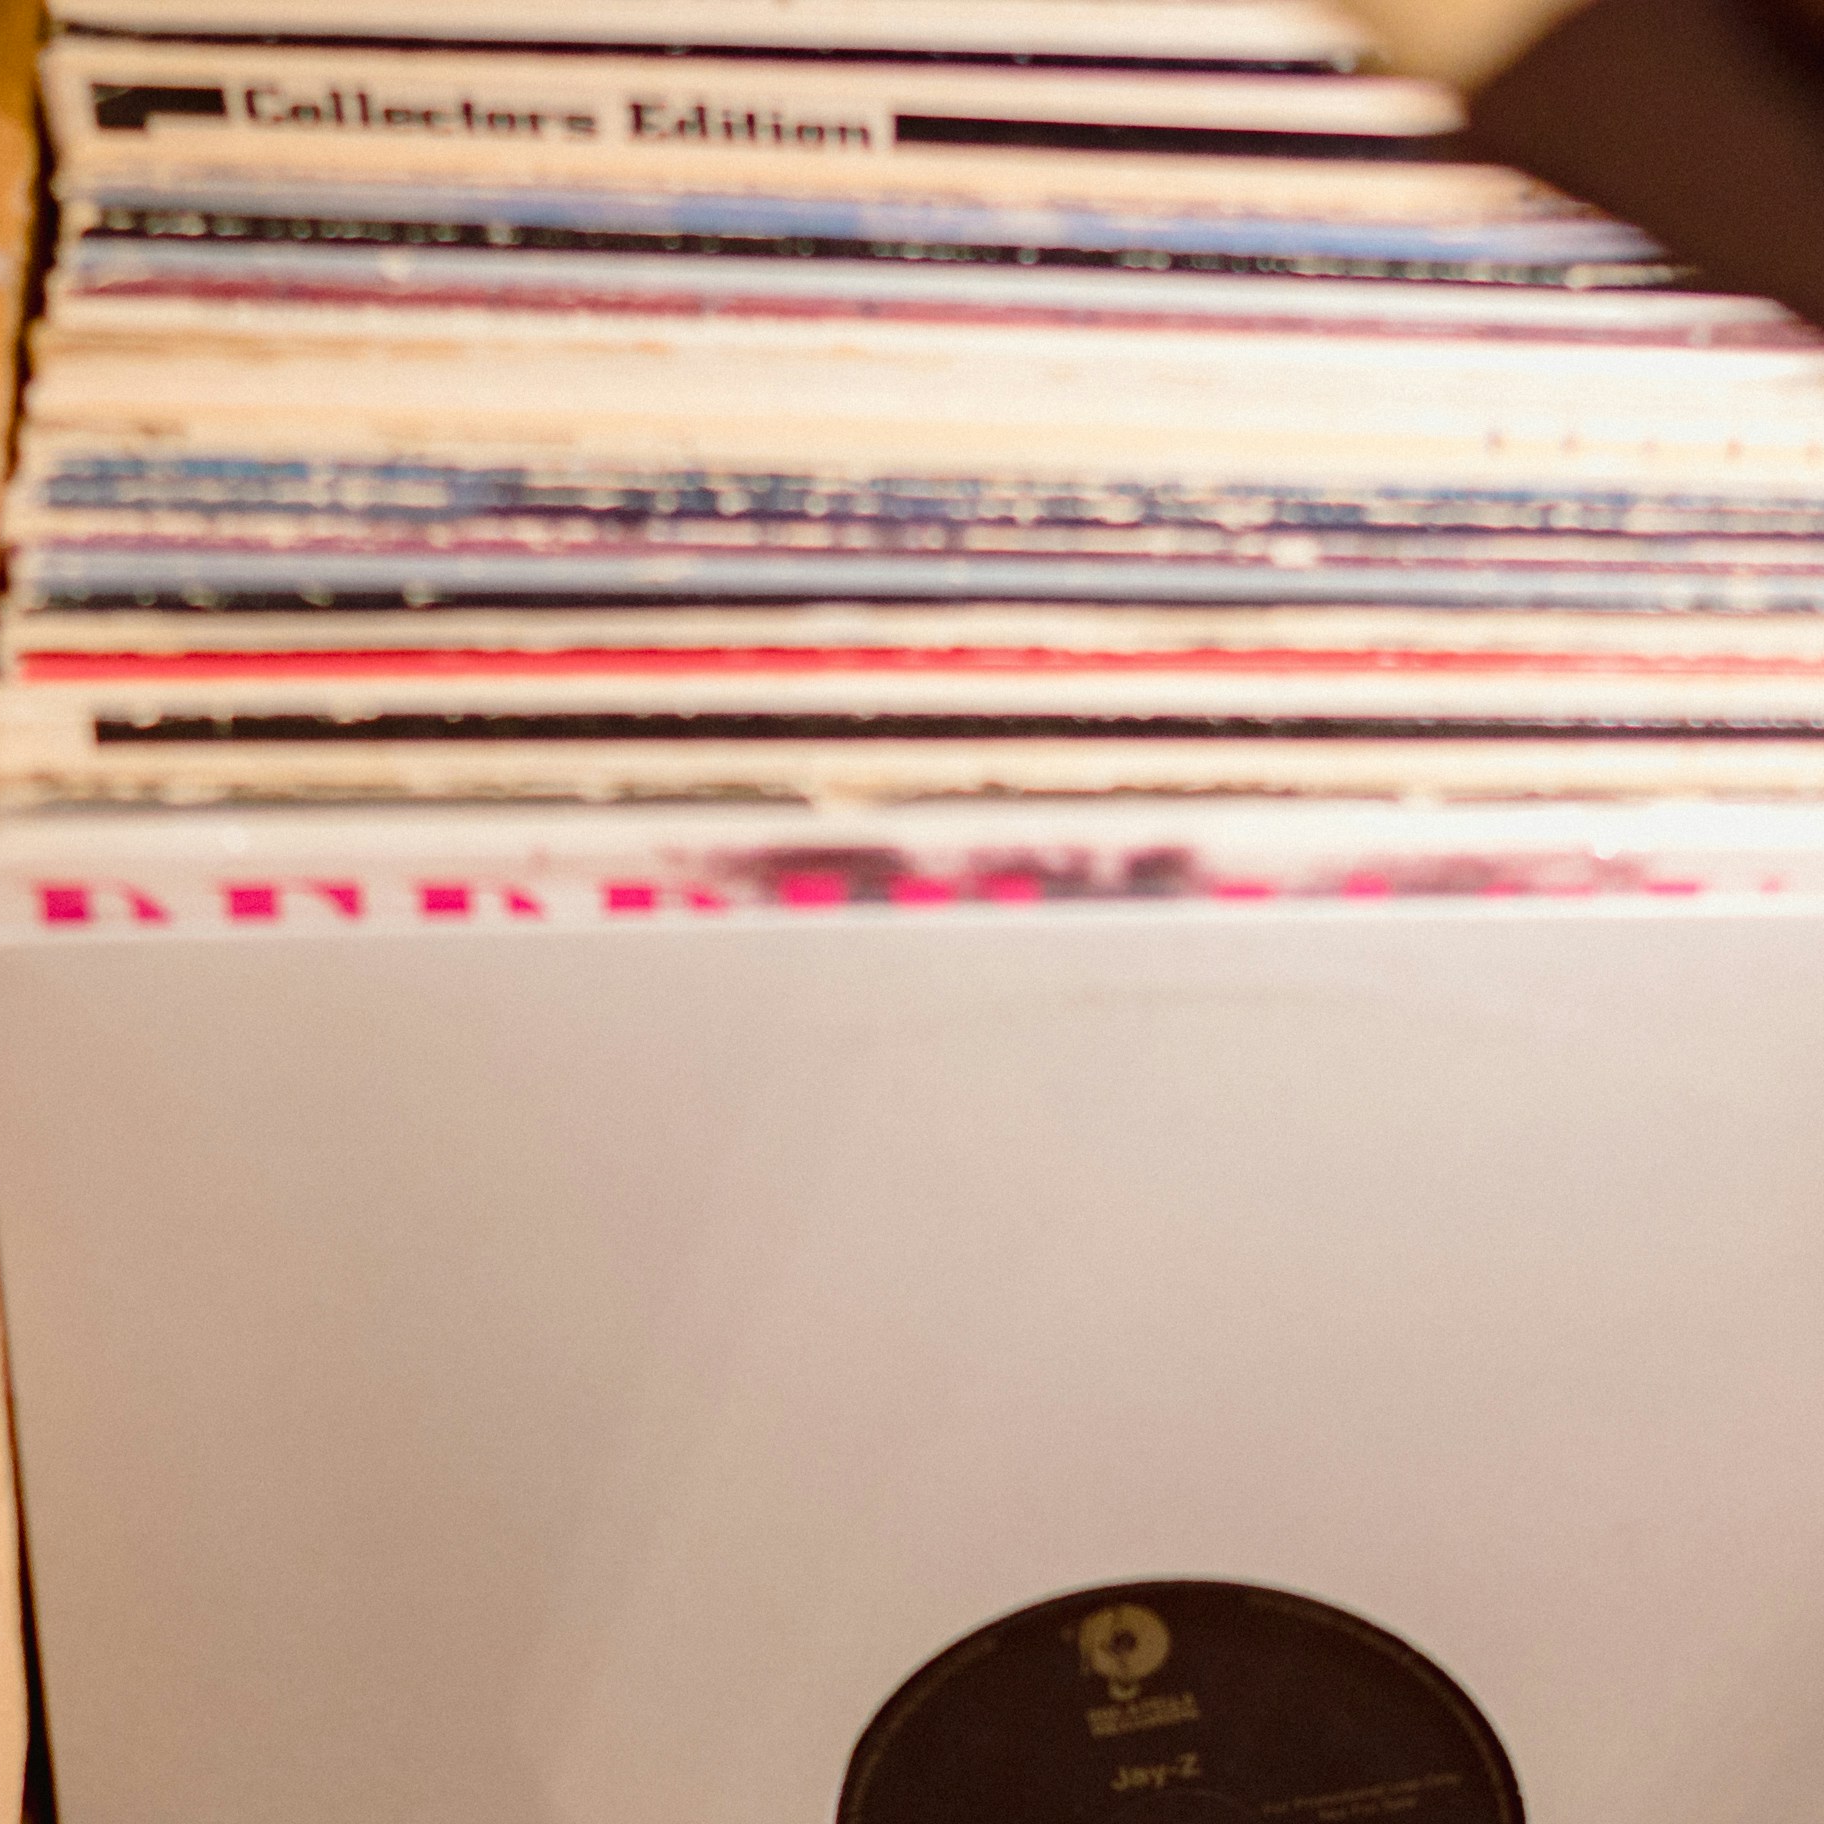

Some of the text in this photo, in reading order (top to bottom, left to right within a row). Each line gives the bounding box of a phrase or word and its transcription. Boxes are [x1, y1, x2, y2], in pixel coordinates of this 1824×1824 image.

[243, 83, 875, 150] Collectors Edition
[1110, 1751, 1202, 1791] Jay-Z
